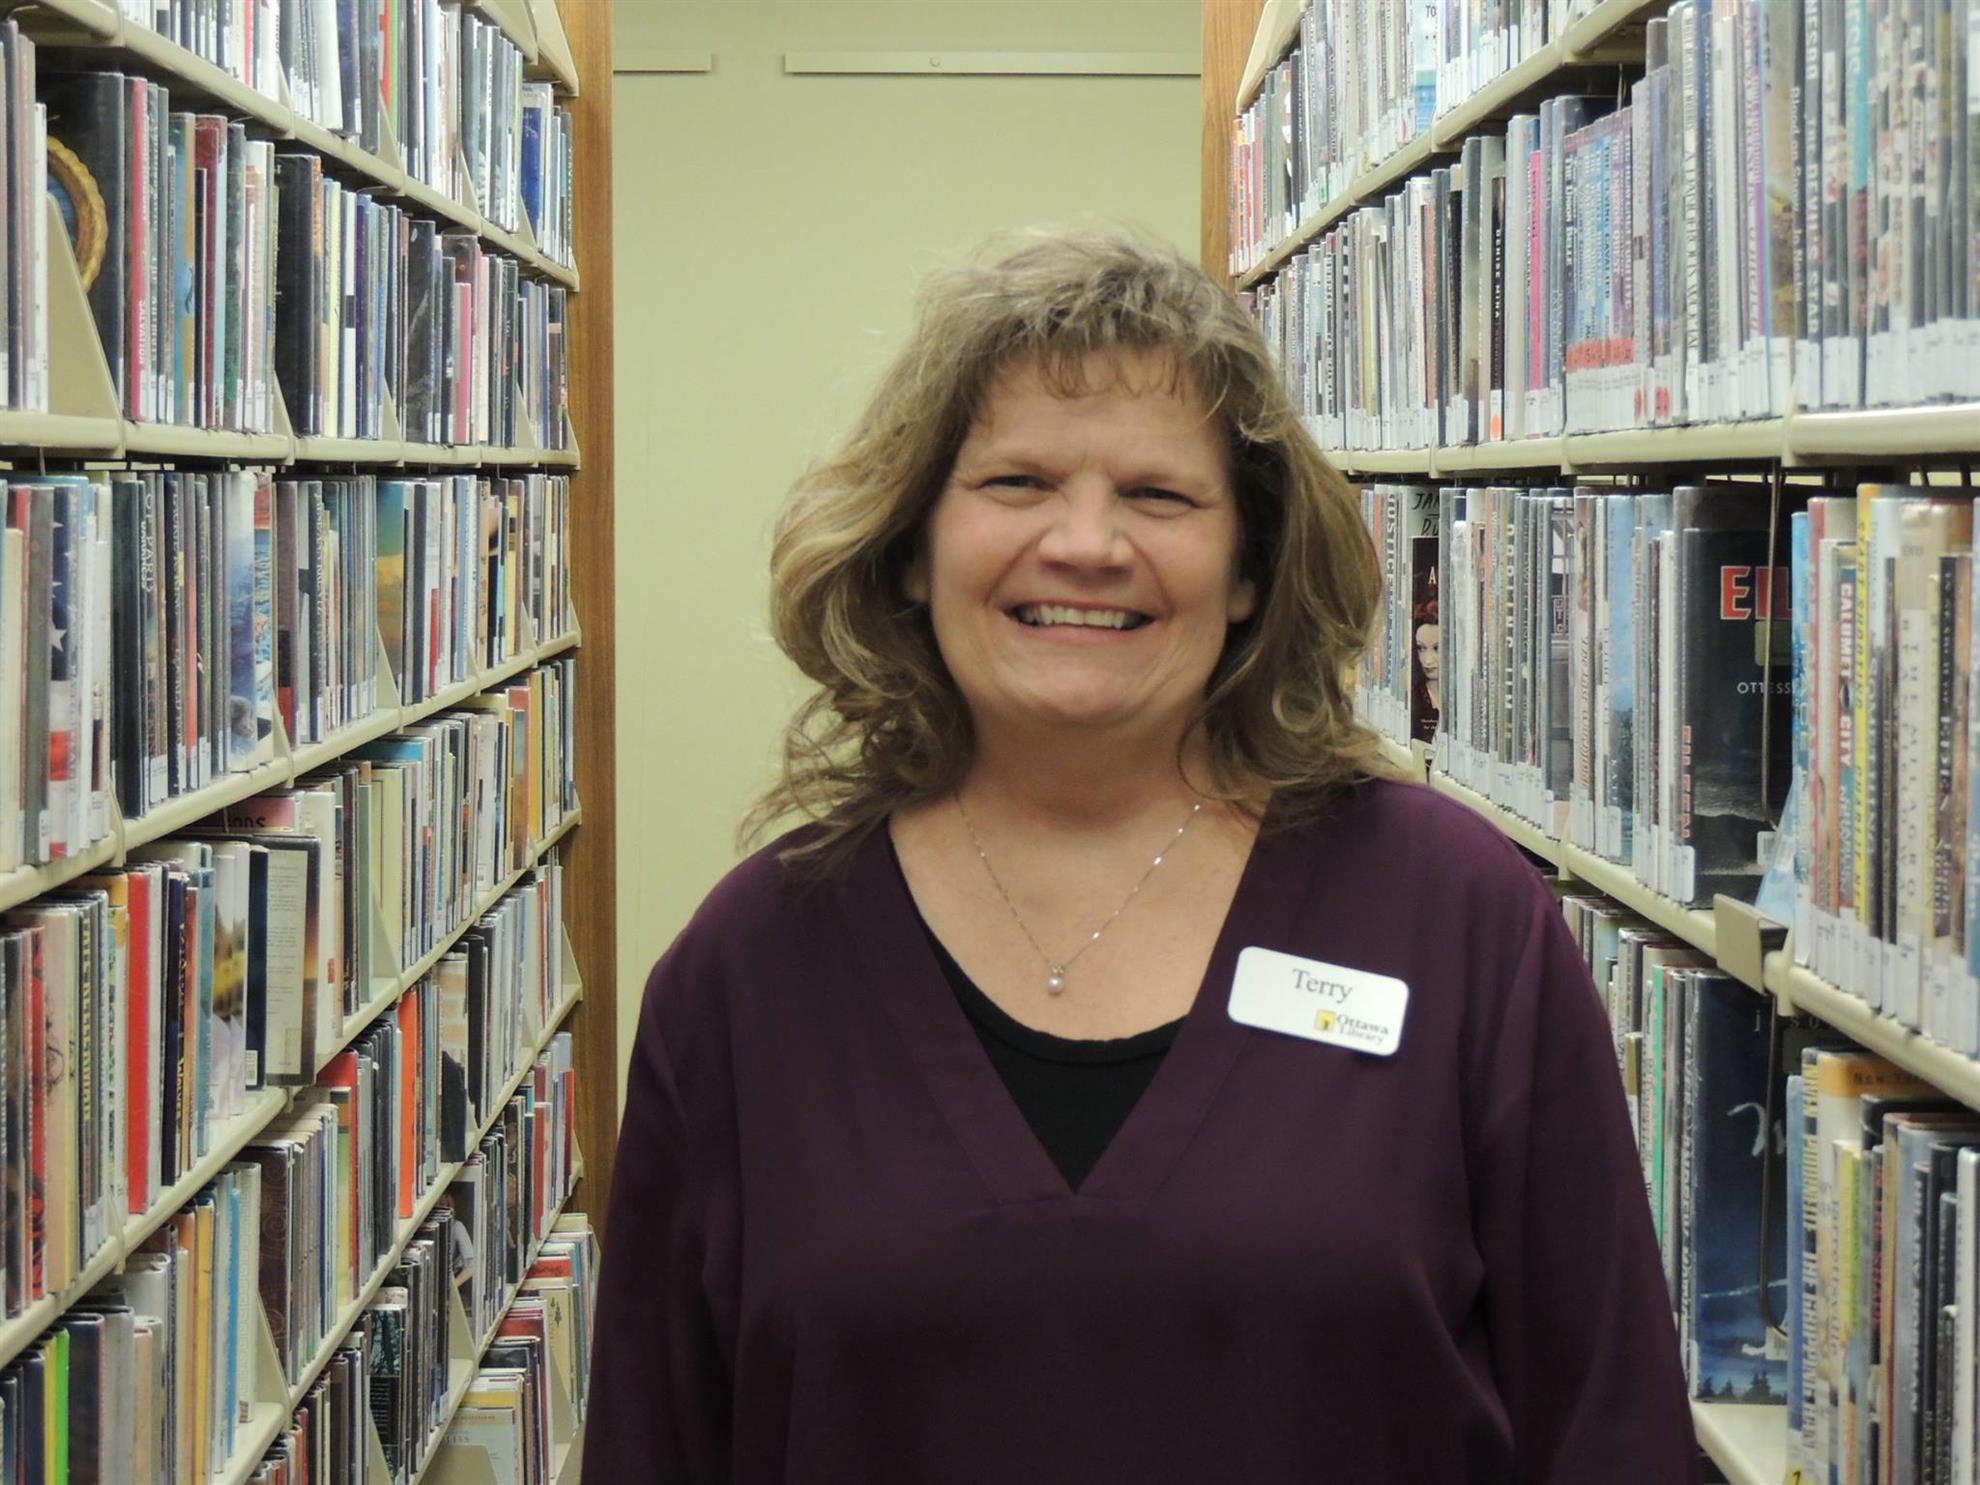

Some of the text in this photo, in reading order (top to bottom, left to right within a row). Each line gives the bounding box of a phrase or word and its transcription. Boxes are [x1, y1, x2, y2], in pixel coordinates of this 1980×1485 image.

[1807, 270, 1819, 333] STAR
[1840, 582, 1853, 770] CALUMET CITY
[1291, 967, 1353, 1004] Terry
[1336, 1013, 1389, 1036] Ottawa
[1339, 1025, 1385, 1046] Library
